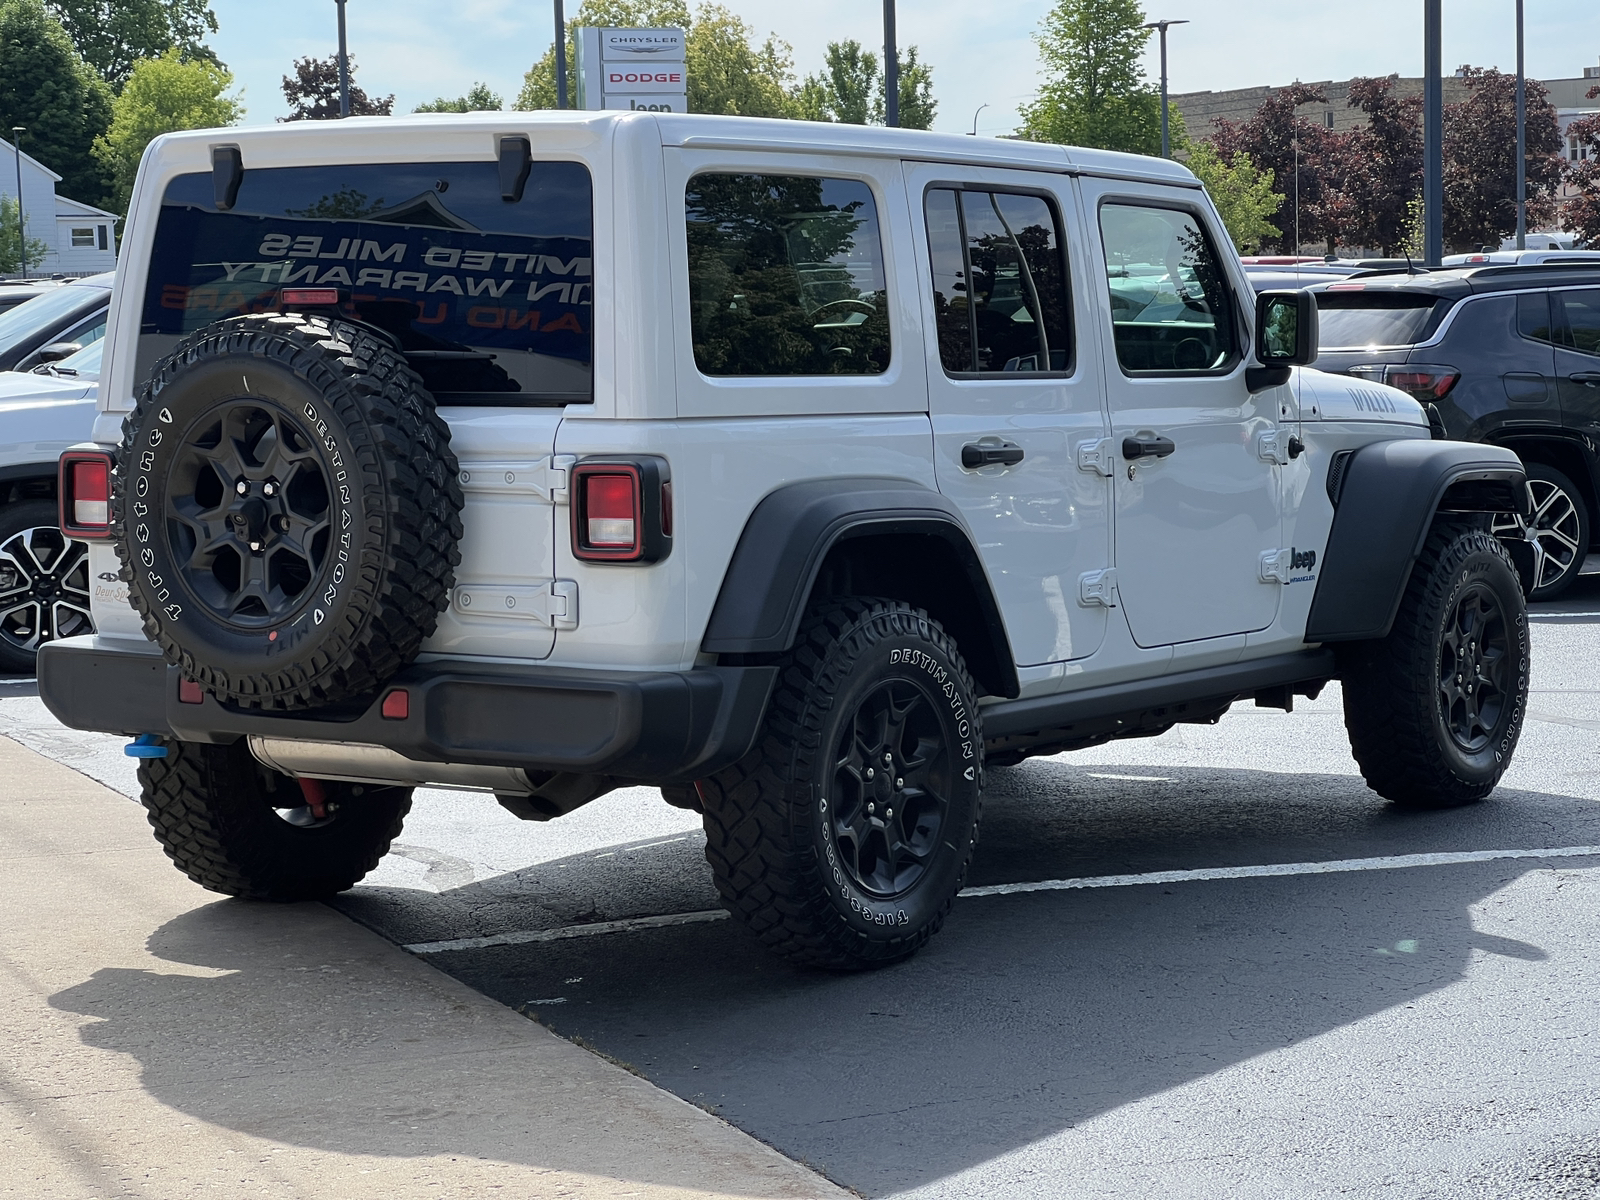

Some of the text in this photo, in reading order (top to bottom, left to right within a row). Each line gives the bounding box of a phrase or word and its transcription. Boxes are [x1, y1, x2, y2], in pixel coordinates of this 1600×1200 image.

[609, 73, 681, 83] DODGE
[303, 402, 353, 607] DESTINATION
[1290, 547, 1317, 572] Jeep
[95, 585, 115, 597] Deur
[889, 648, 974, 759] DESTINATION
